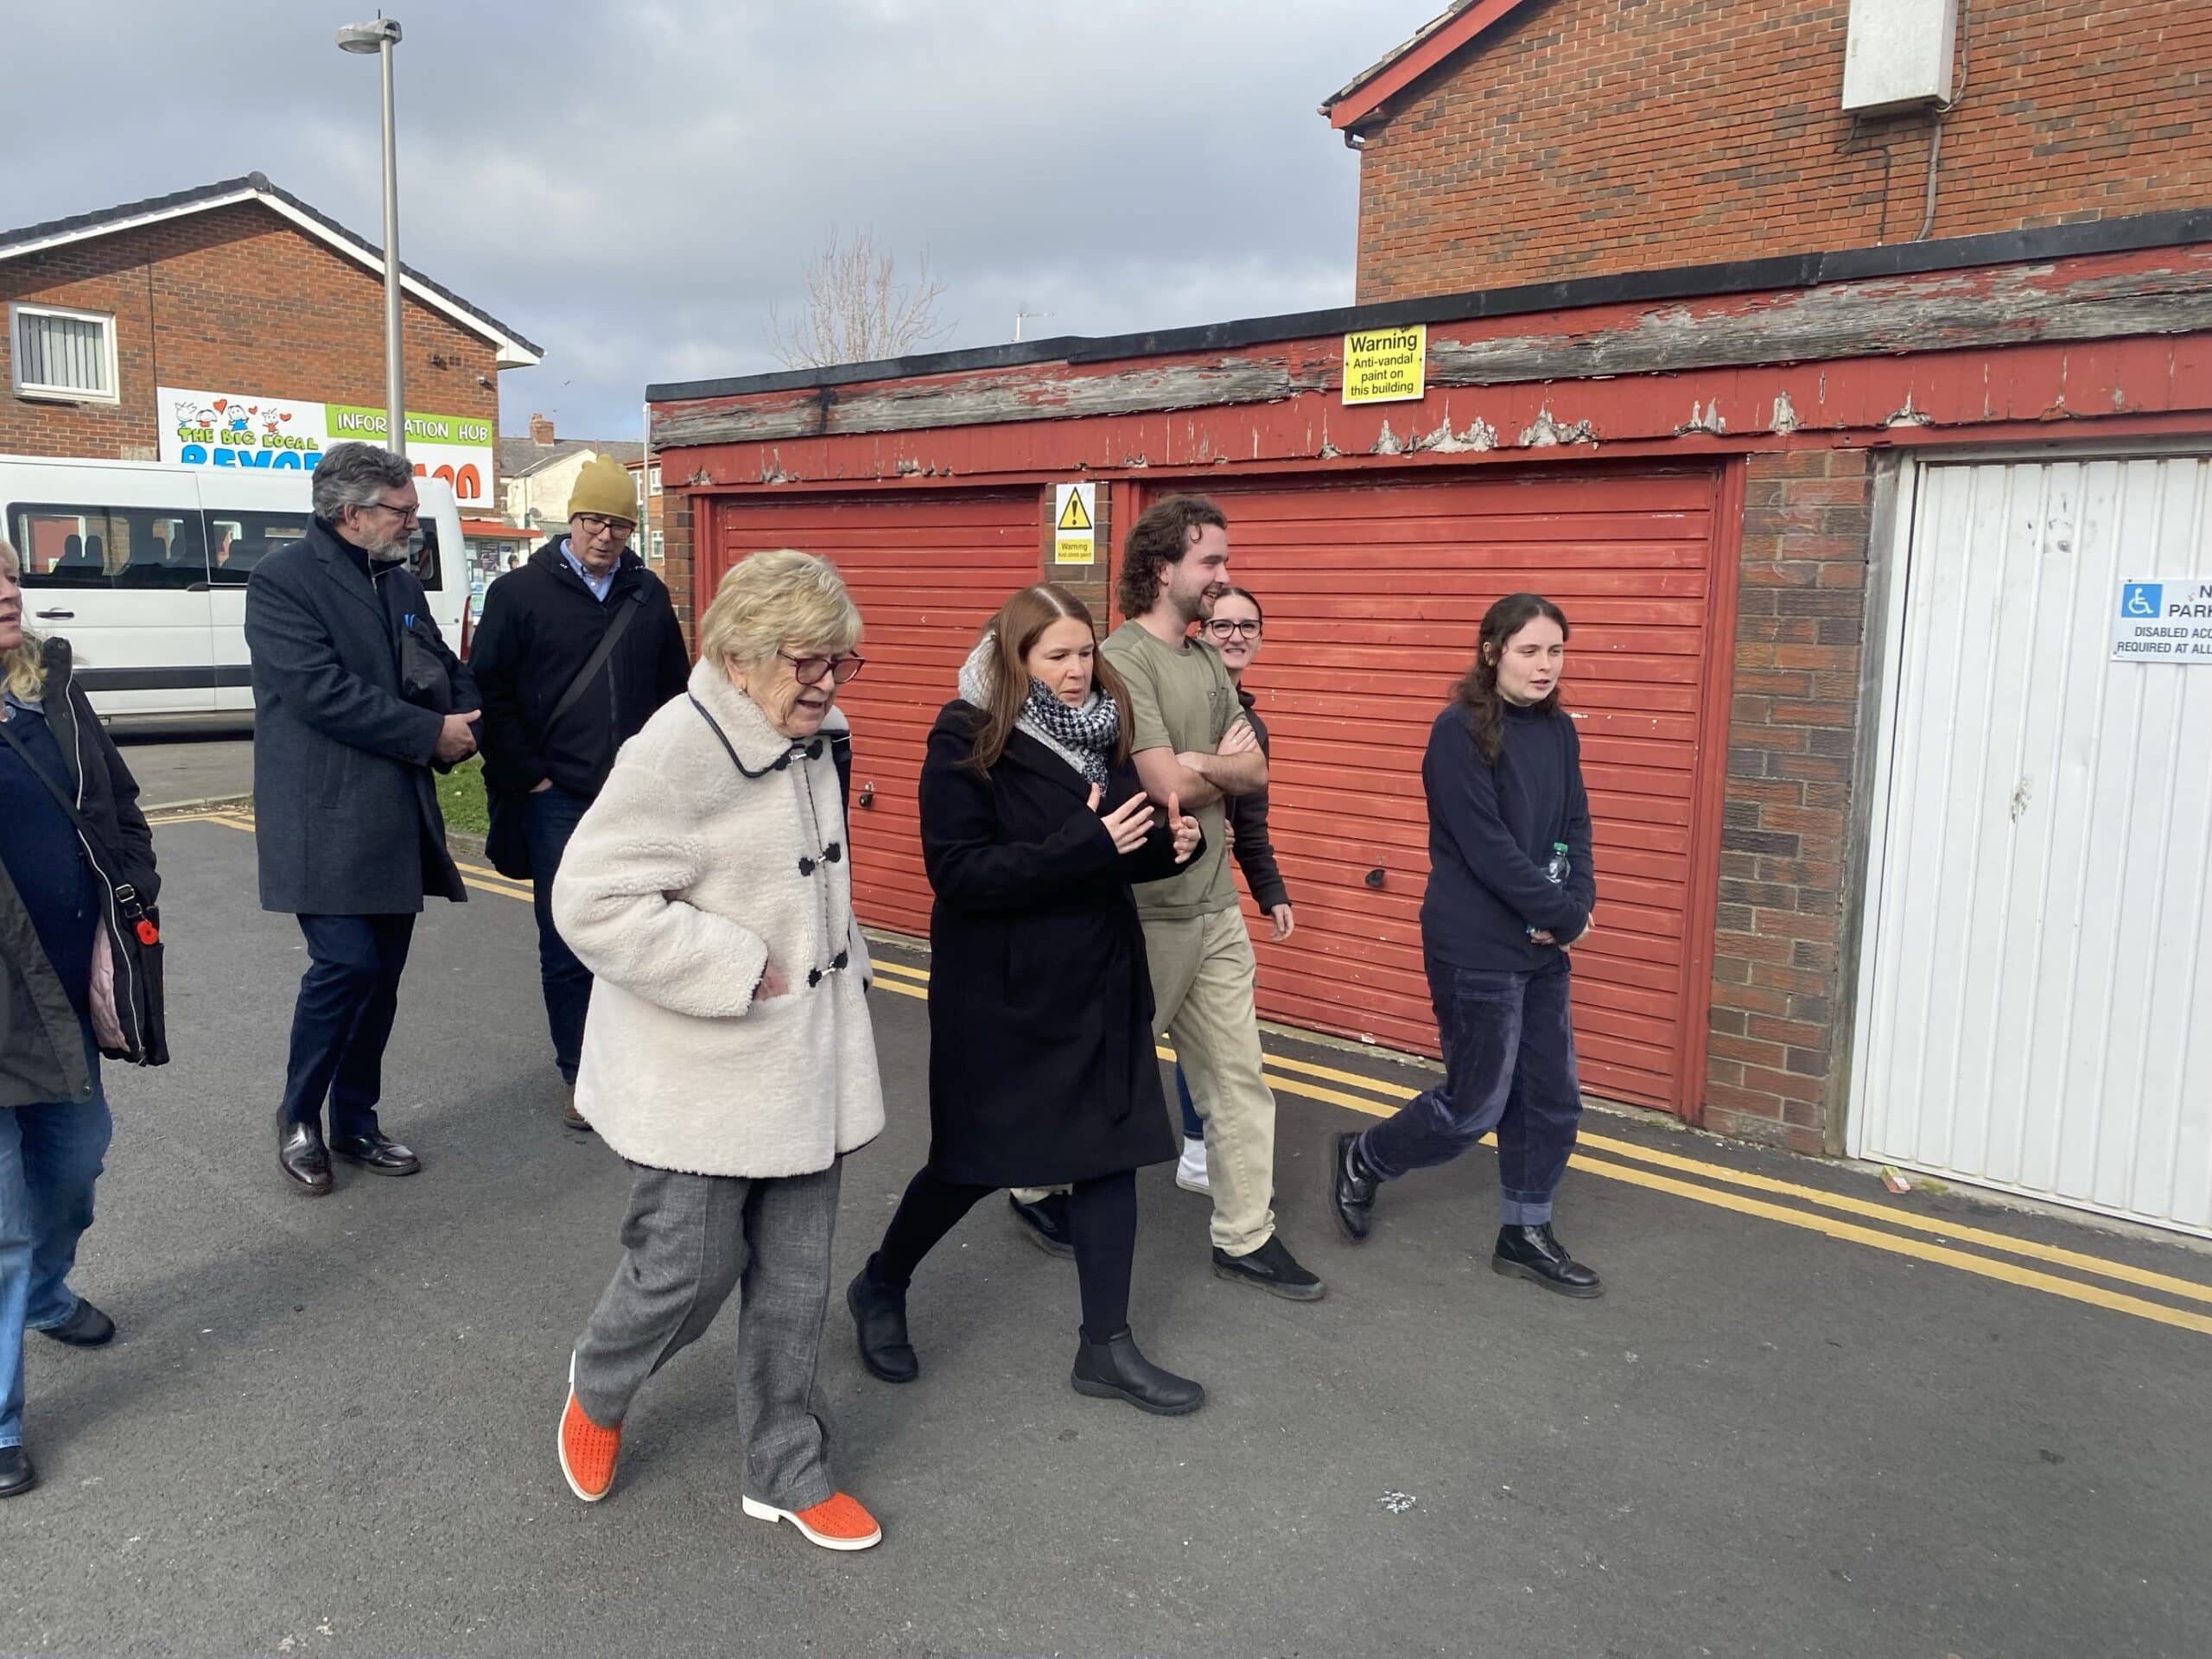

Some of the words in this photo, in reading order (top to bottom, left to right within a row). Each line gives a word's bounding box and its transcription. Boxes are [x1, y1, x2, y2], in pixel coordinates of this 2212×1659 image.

[1351, 333, 1417, 353] Warning
[1353, 353, 1414, 369] Anti-vandal
[1361, 369, 1388, 384] paint
[1389, 370, 1404, 379] on
[1351, 385, 1370, 397] this
[1371, 382, 1414, 394] building
[337, 413, 449, 439] INFORATION
[458, 424, 489, 442] HUB
[177, 427, 213, 443] THE
[221, 429, 256, 446] BIG
[262, 435, 319, 450] LOCAL
[2134, 626, 2189, 639] DISABLED
[2116, 641, 2172, 654] REQUIRED
[2175, 643, 2190, 654] AT
[2191, 644, 2212, 655] ALL
